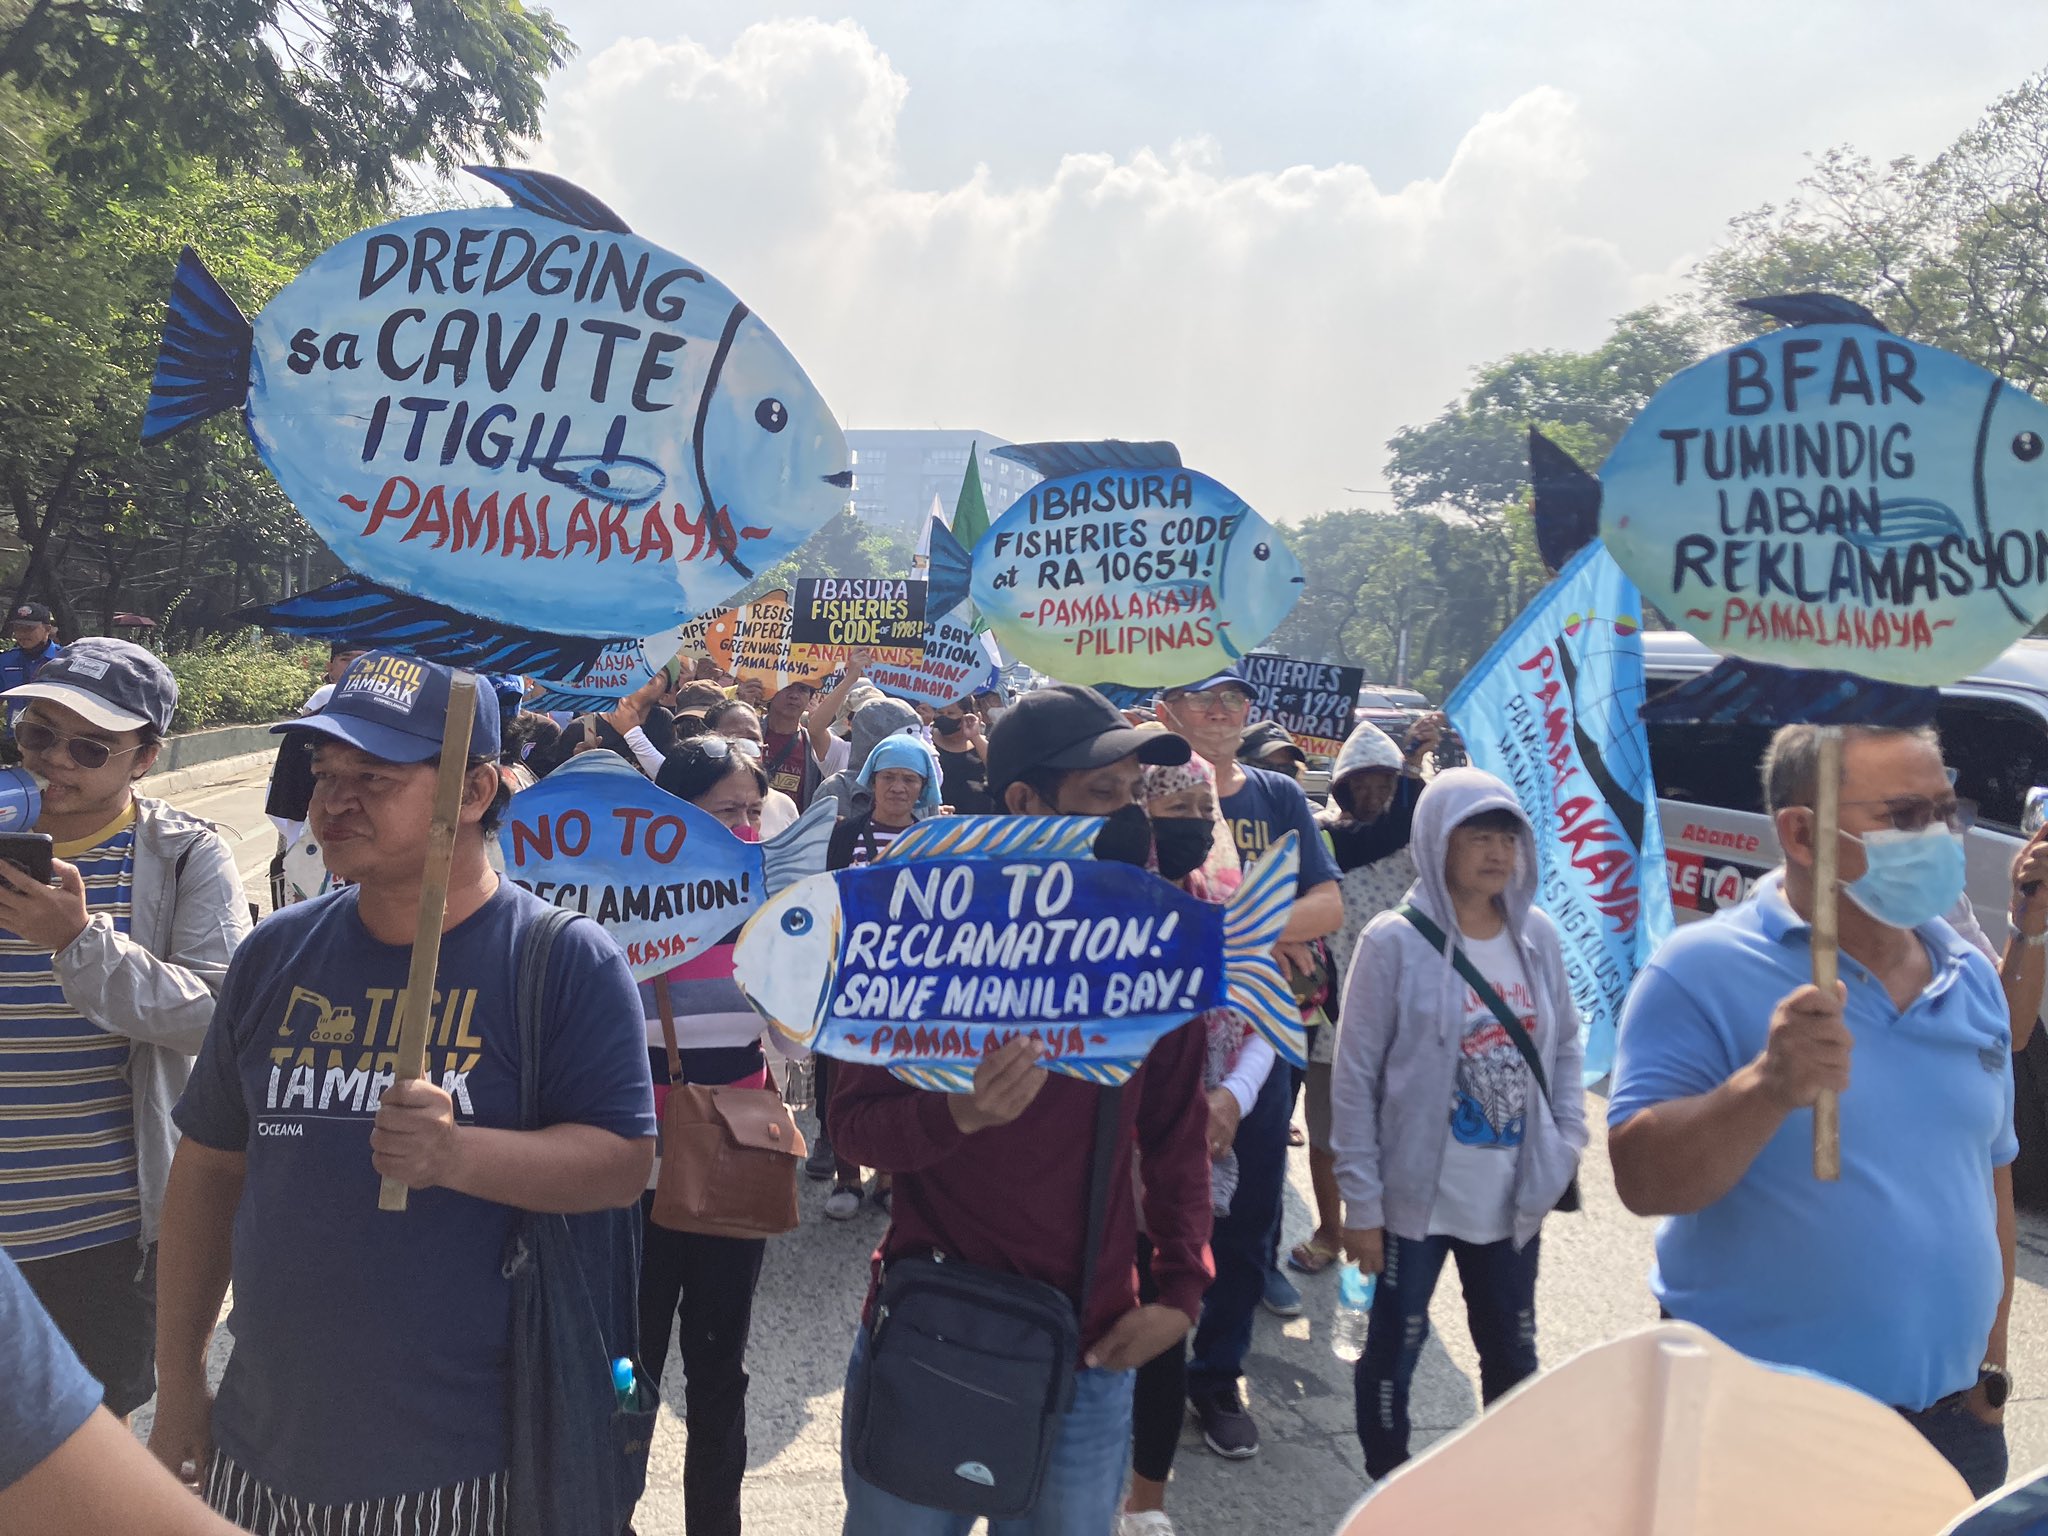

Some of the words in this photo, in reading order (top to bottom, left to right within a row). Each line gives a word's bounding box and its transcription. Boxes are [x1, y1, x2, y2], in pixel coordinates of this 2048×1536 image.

[358, 226, 706, 324] DREDGING
[287, 327, 363, 375] sa
[376, 307, 688, 412] CAVITE
[1727, 337, 1925, 416] BFAR
[1659, 420, 1915, 485] TUMINDIG
[1029, 473, 1193, 525] IBASURA
[1719, 486, 1881, 536] LABAN
[995, 519, 1147, 558] FISHERIES
[1162, 515, 1240, 545] CODE
[992, 568, 1020, 590] at
[1038, 565, 1084, 590] RA
[1096, 544, 1216, 584] 10654!
[813, 579, 908, 600] IBASURA
[752, 603, 793, 622] RESIS
[811, 599, 909, 621] FISHERIES
[720, 638, 792, 656] GREENWASH
[733, 620, 793, 640] IMPERIA
[829, 620, 881, 644] CODE
[880, 626, 891, 634] OF
[940, 624, 974, 646] BAY
[375, 656, 422, 686] TIGIL
[1246, 658, 1342, 692] ISHERIES
[344, 674, 418, 705] TAMBAK
[1302, 691, 1351, 718] 1998
[1247, 705, 1343, 739] BASURA!
[511, 808, 592, 866] NO
[612, 807, 687, 864] TO
[1682, 823, 1760, 853] Abante
[890, 865, 976, 921] NO
[1002, 861, 1073, 918] TO
[844, 911, 1180, 970] RECLAMATION!
[834, 972, 937, 1020] SAVE
[942, 975, 1088, 1018] MANILA
[1102, 968, 1203, 1017] BAY!
[267, 1047, 482, 1115] TAMBK
[257, 1122, 304, 1137] OCEANA
